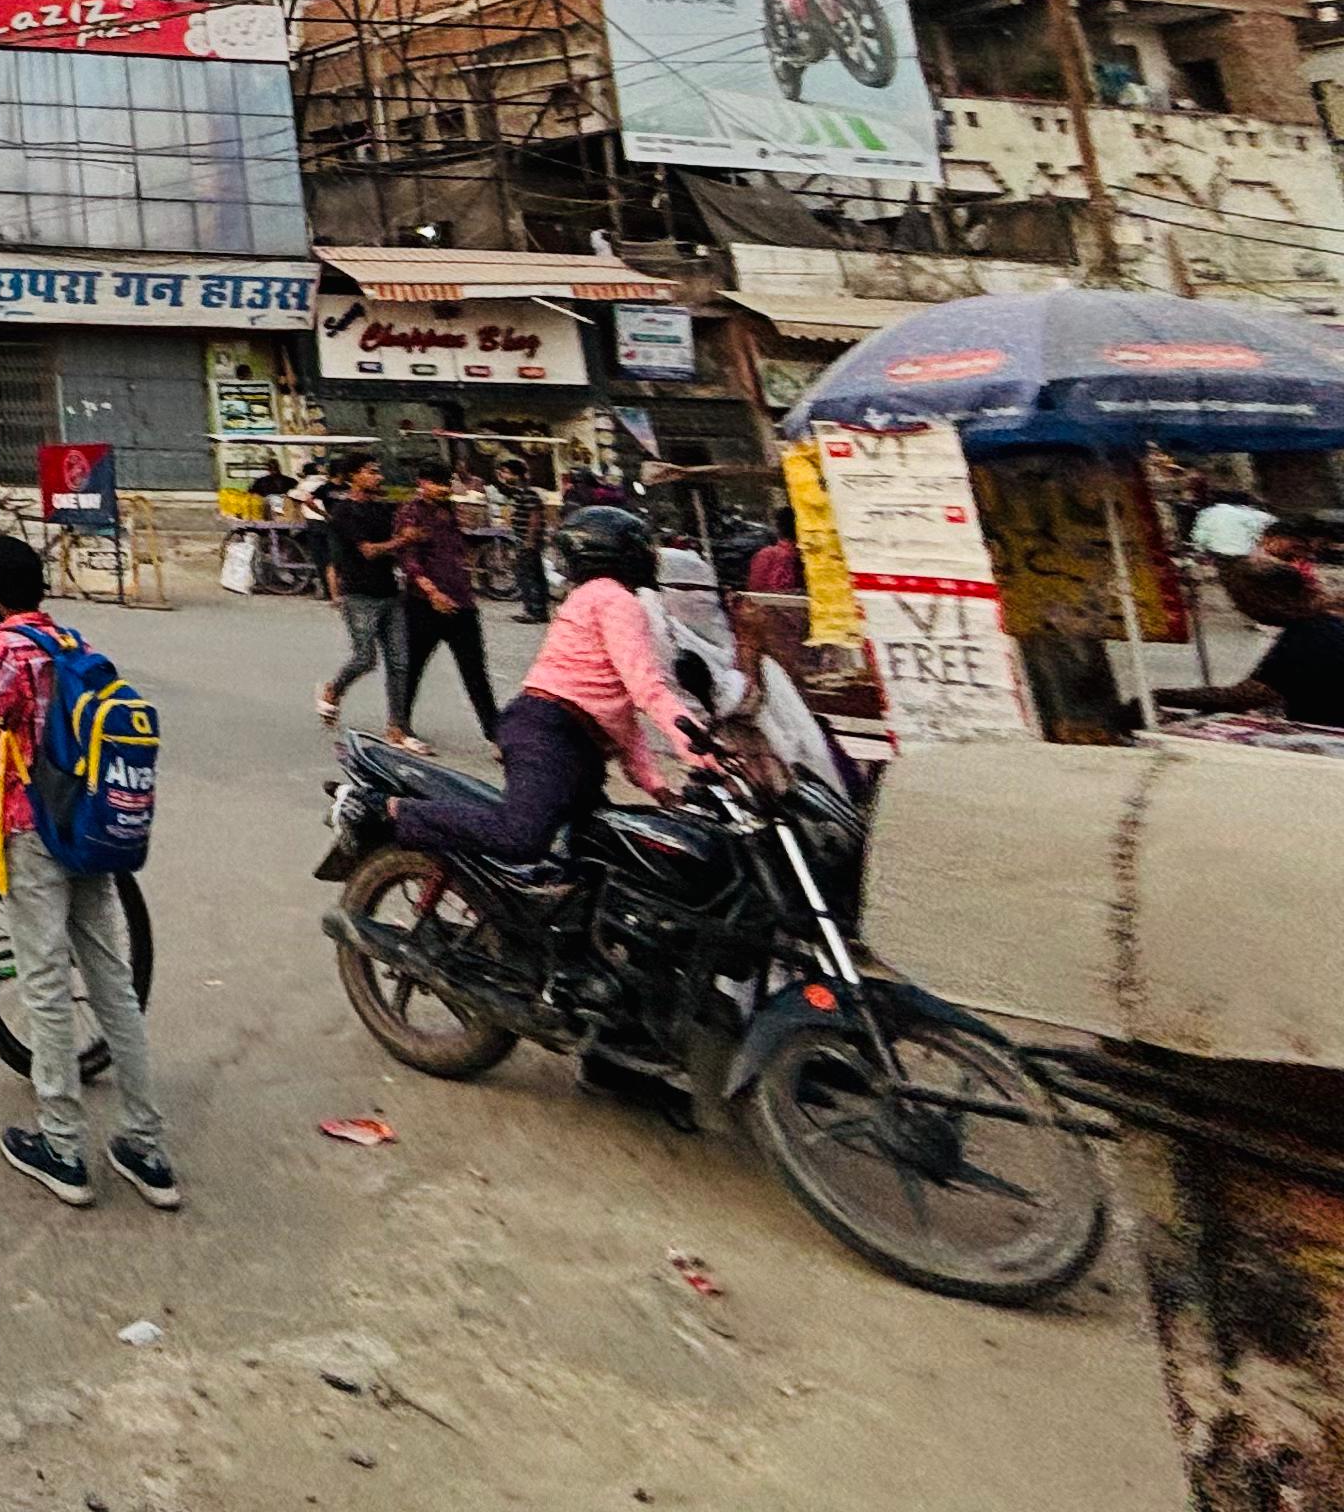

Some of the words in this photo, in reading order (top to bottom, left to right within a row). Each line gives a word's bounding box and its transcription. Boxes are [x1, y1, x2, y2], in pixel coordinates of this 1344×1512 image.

[113, 272, 191, 308] गन
[199, 274, 317, 312] हाउस
[884, 641, 993, 689] FREE
